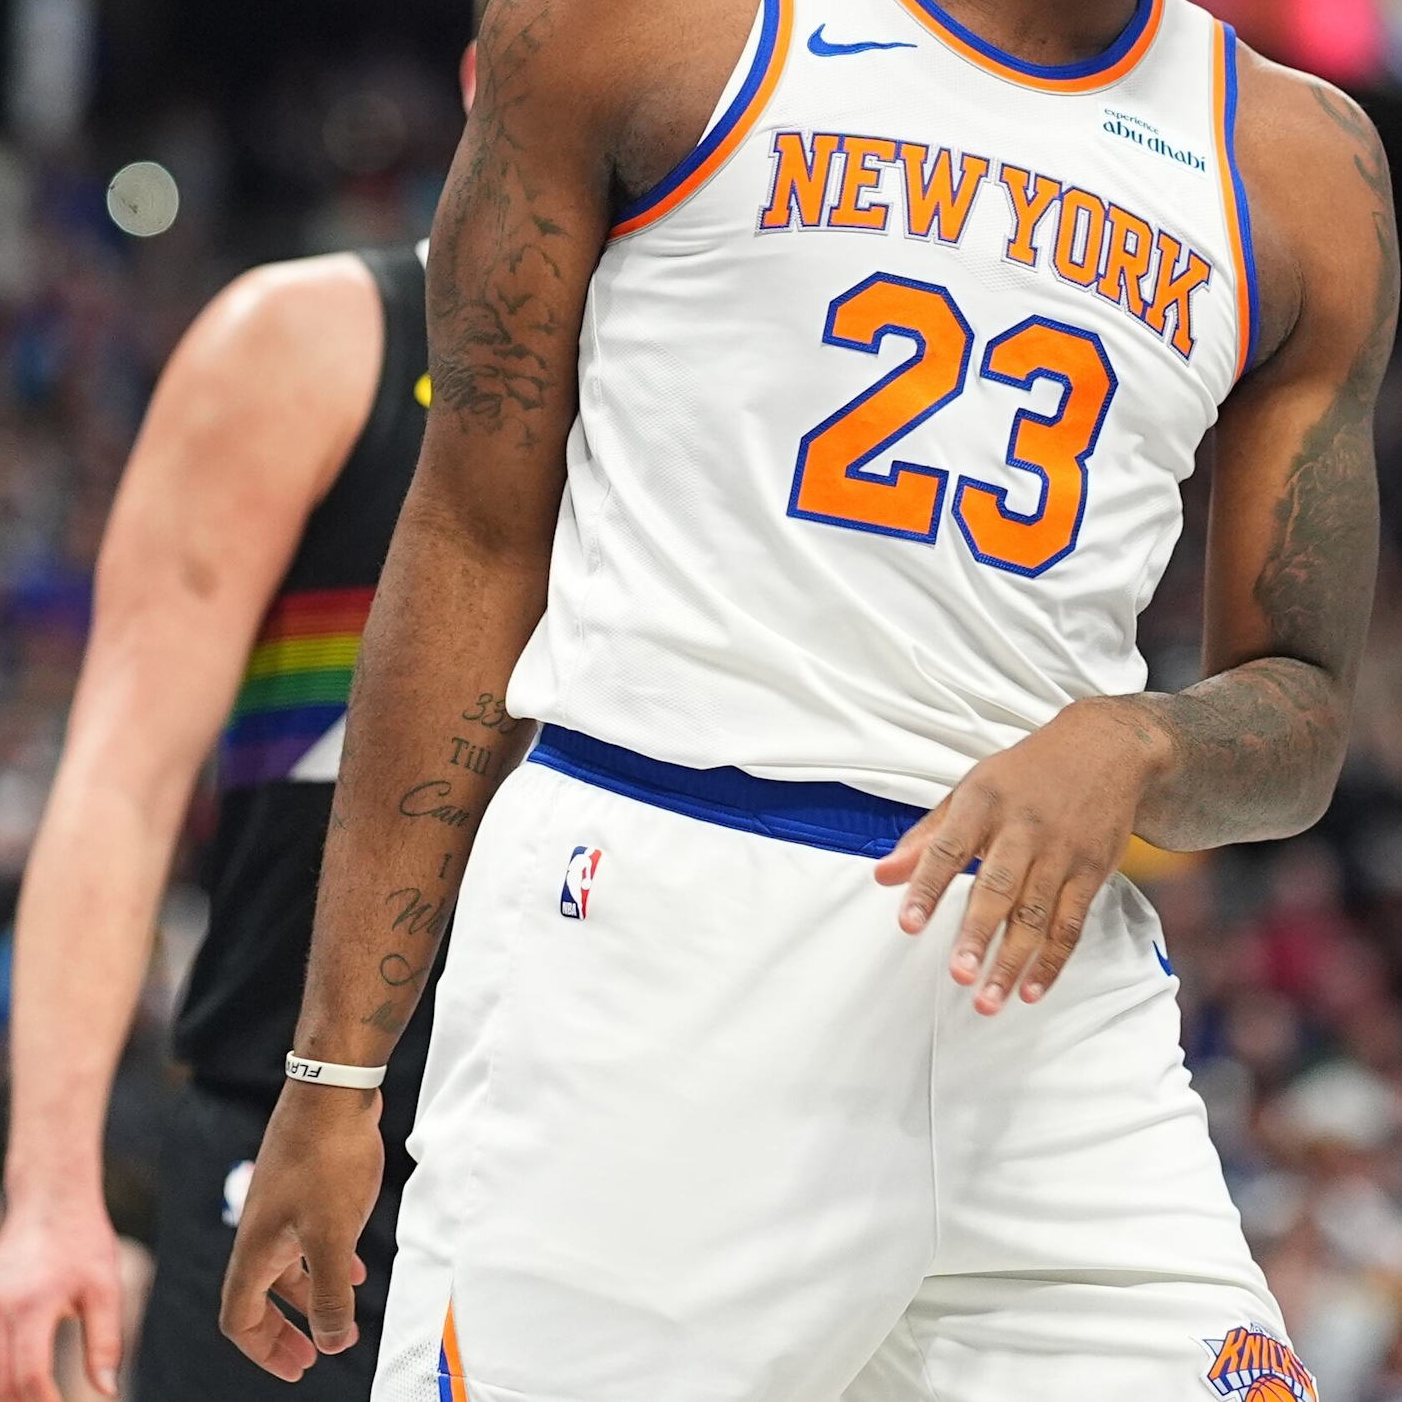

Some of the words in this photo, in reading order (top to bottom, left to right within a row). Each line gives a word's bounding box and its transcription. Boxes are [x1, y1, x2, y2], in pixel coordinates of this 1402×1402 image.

[1102, 120, 1144, 146] abu
[1146, 137, 1206, 173] dhabi
[1103, 108, 1159, 135] experience
[759, 129, 991, 246] NEW
[997, 163, 1212, 362] YORK
[786, 270, 1119, 579] 23
[561, 901, 578, 917] NBA
